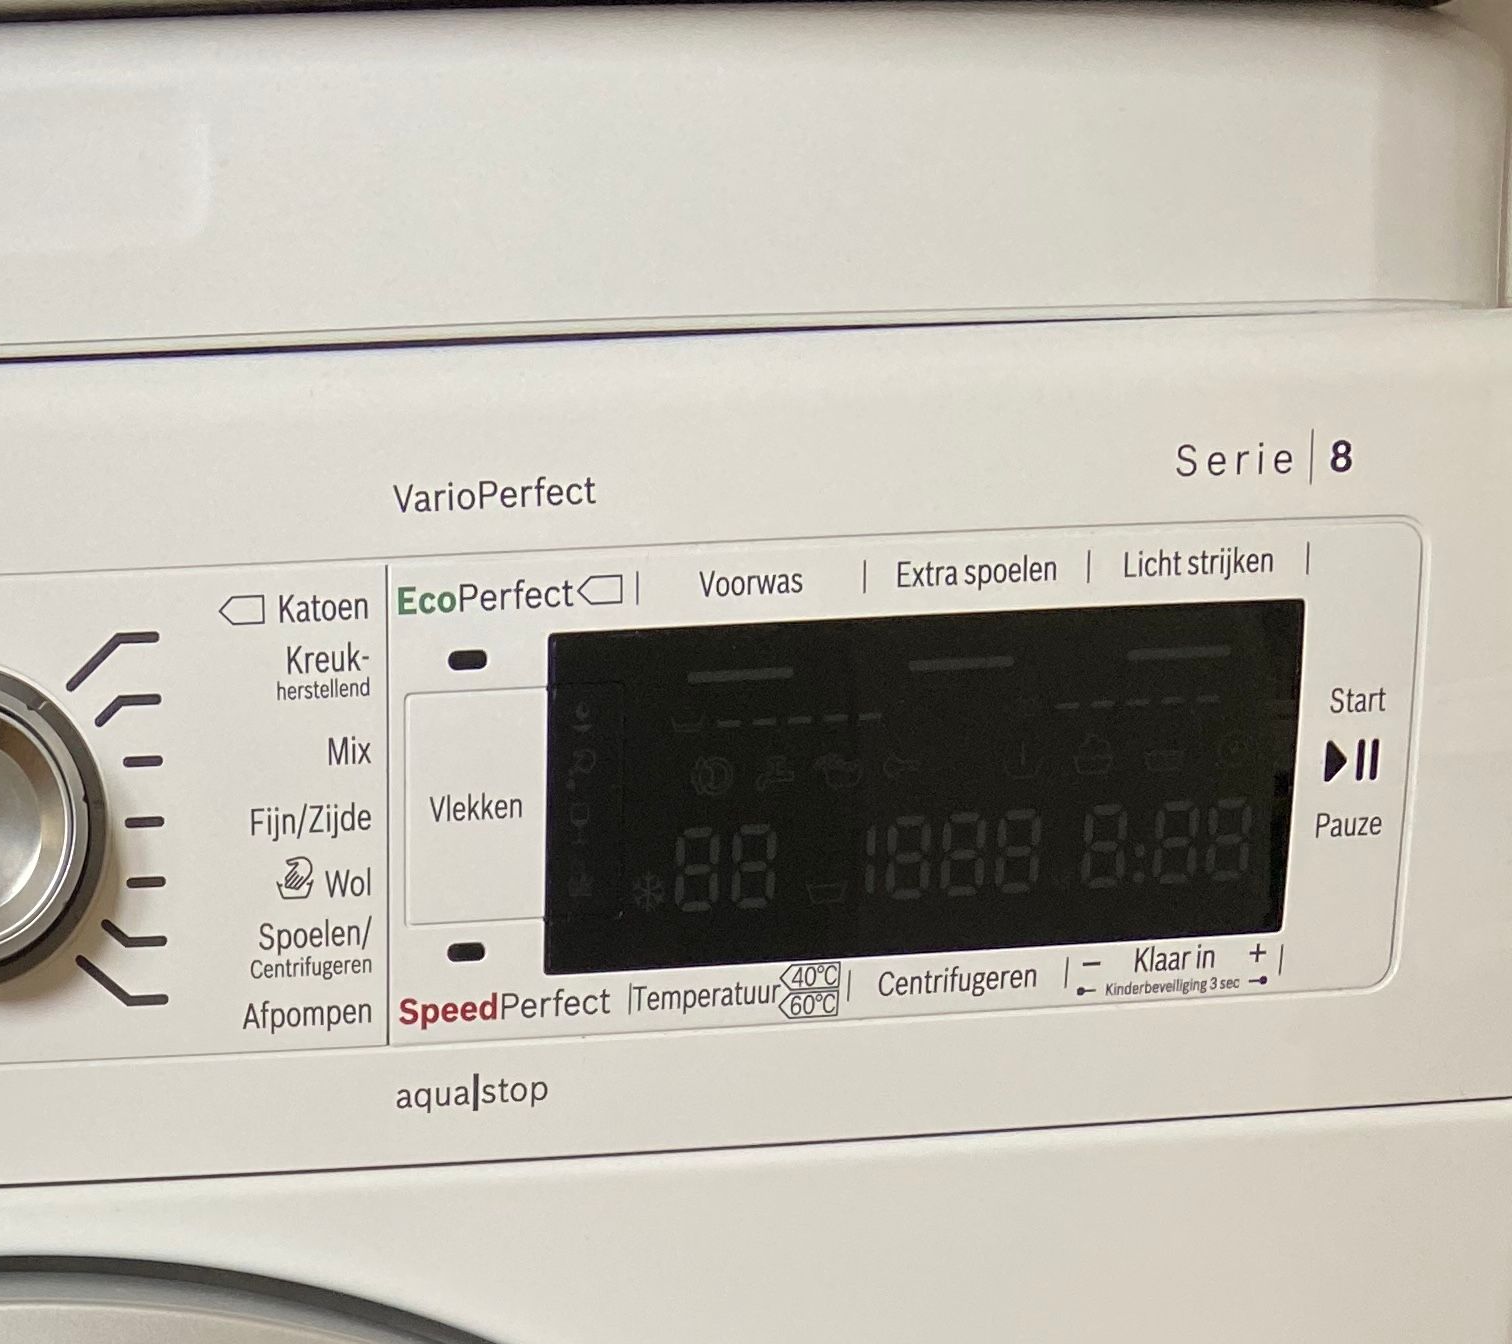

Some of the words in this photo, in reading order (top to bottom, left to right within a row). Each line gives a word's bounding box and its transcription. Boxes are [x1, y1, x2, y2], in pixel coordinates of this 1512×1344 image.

[1176, 442, 1293, 477] Serie
[1330, 439, 1352, 473] 8
[393, 476, 596, 513] VarioPerfect
[897, 561, 957, 588] Extra
[964, 554, 1057, 591] spoelen
[1124, 549, 1182, 578] Licht
[1187, 546, 1274, 580] strijken
[397, 579, 574, 615] EcoPerfect
[699, 570, 803, 598] Voorwas
[278, 594, 369, 623] Katoen
[286, 641, 370, 675] Kreuk-
[276, 677, 371, 701] herstellend
[1329, 687, 1386, 713] Start
[327, 736, 371, 766] Mix
[250, 801, 372, 842] Fijn/Zijde
[429, 792, 523, 823] Vlekken
[1315, 812, 1383, 838] Pauze
[325, 867, 371, 897] Wol
[259, 915, 372, 956] Spoelen/
[250, 956, 372, 980] Centrifugeren
[1134, 946, 1192, 973] Klaar
[1195, 945, 1215, 968] in
[791, 964, 838, 988] 40°C
[878, 964, 1037, 997] Centrifugeren
[1209, 976, 1218, 990] 3
[1219, 977, 1240, 990] sec
[398, 989, 611, 1030] SpeedPerfect
[632, 982, 781, 1015] Temperatuur
[790, 993, 835, 1016] 60°C
[242, 1001, 372, 1034] Afpompen
